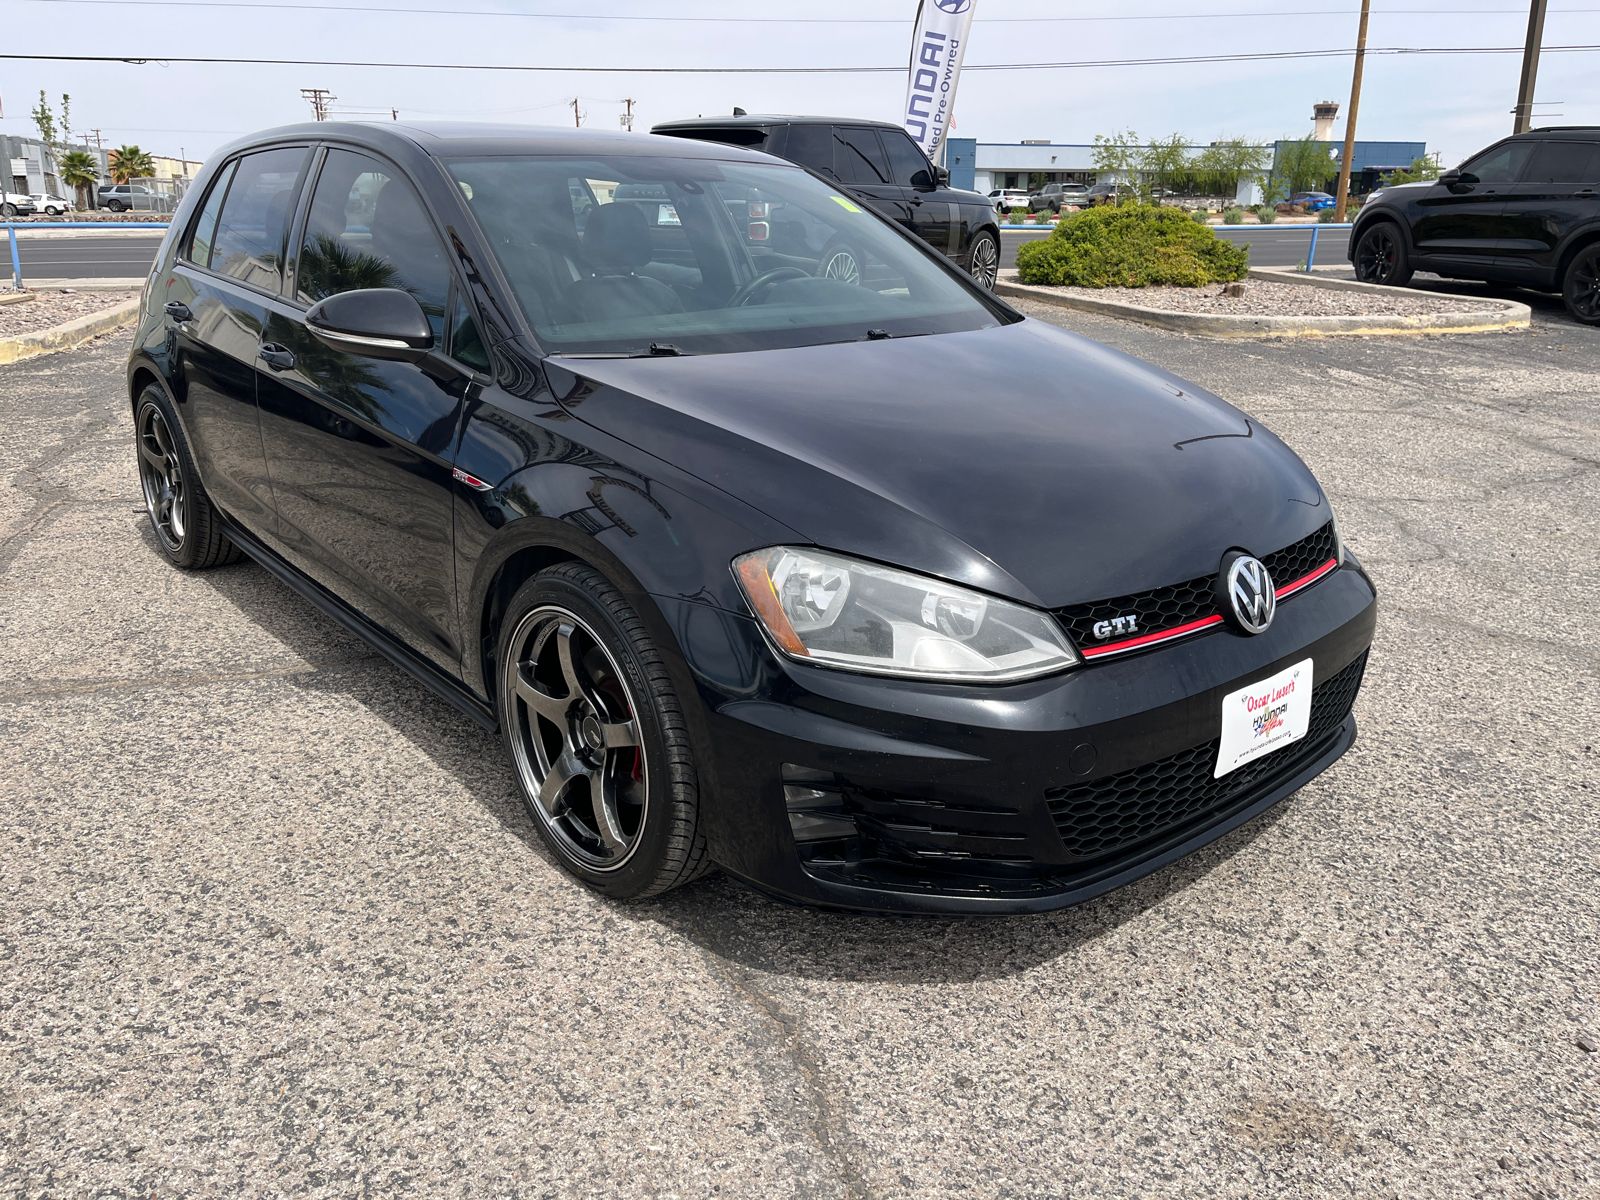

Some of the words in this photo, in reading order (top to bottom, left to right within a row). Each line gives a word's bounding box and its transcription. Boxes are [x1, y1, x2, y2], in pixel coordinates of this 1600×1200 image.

[934, 39, 959, 124] Pre-Owned
[1093, 614, 1139, 639] GTI
[1247, 694, 1271, 713] Oscar
[1253, 703, 1288, 728] HYUNDAI
